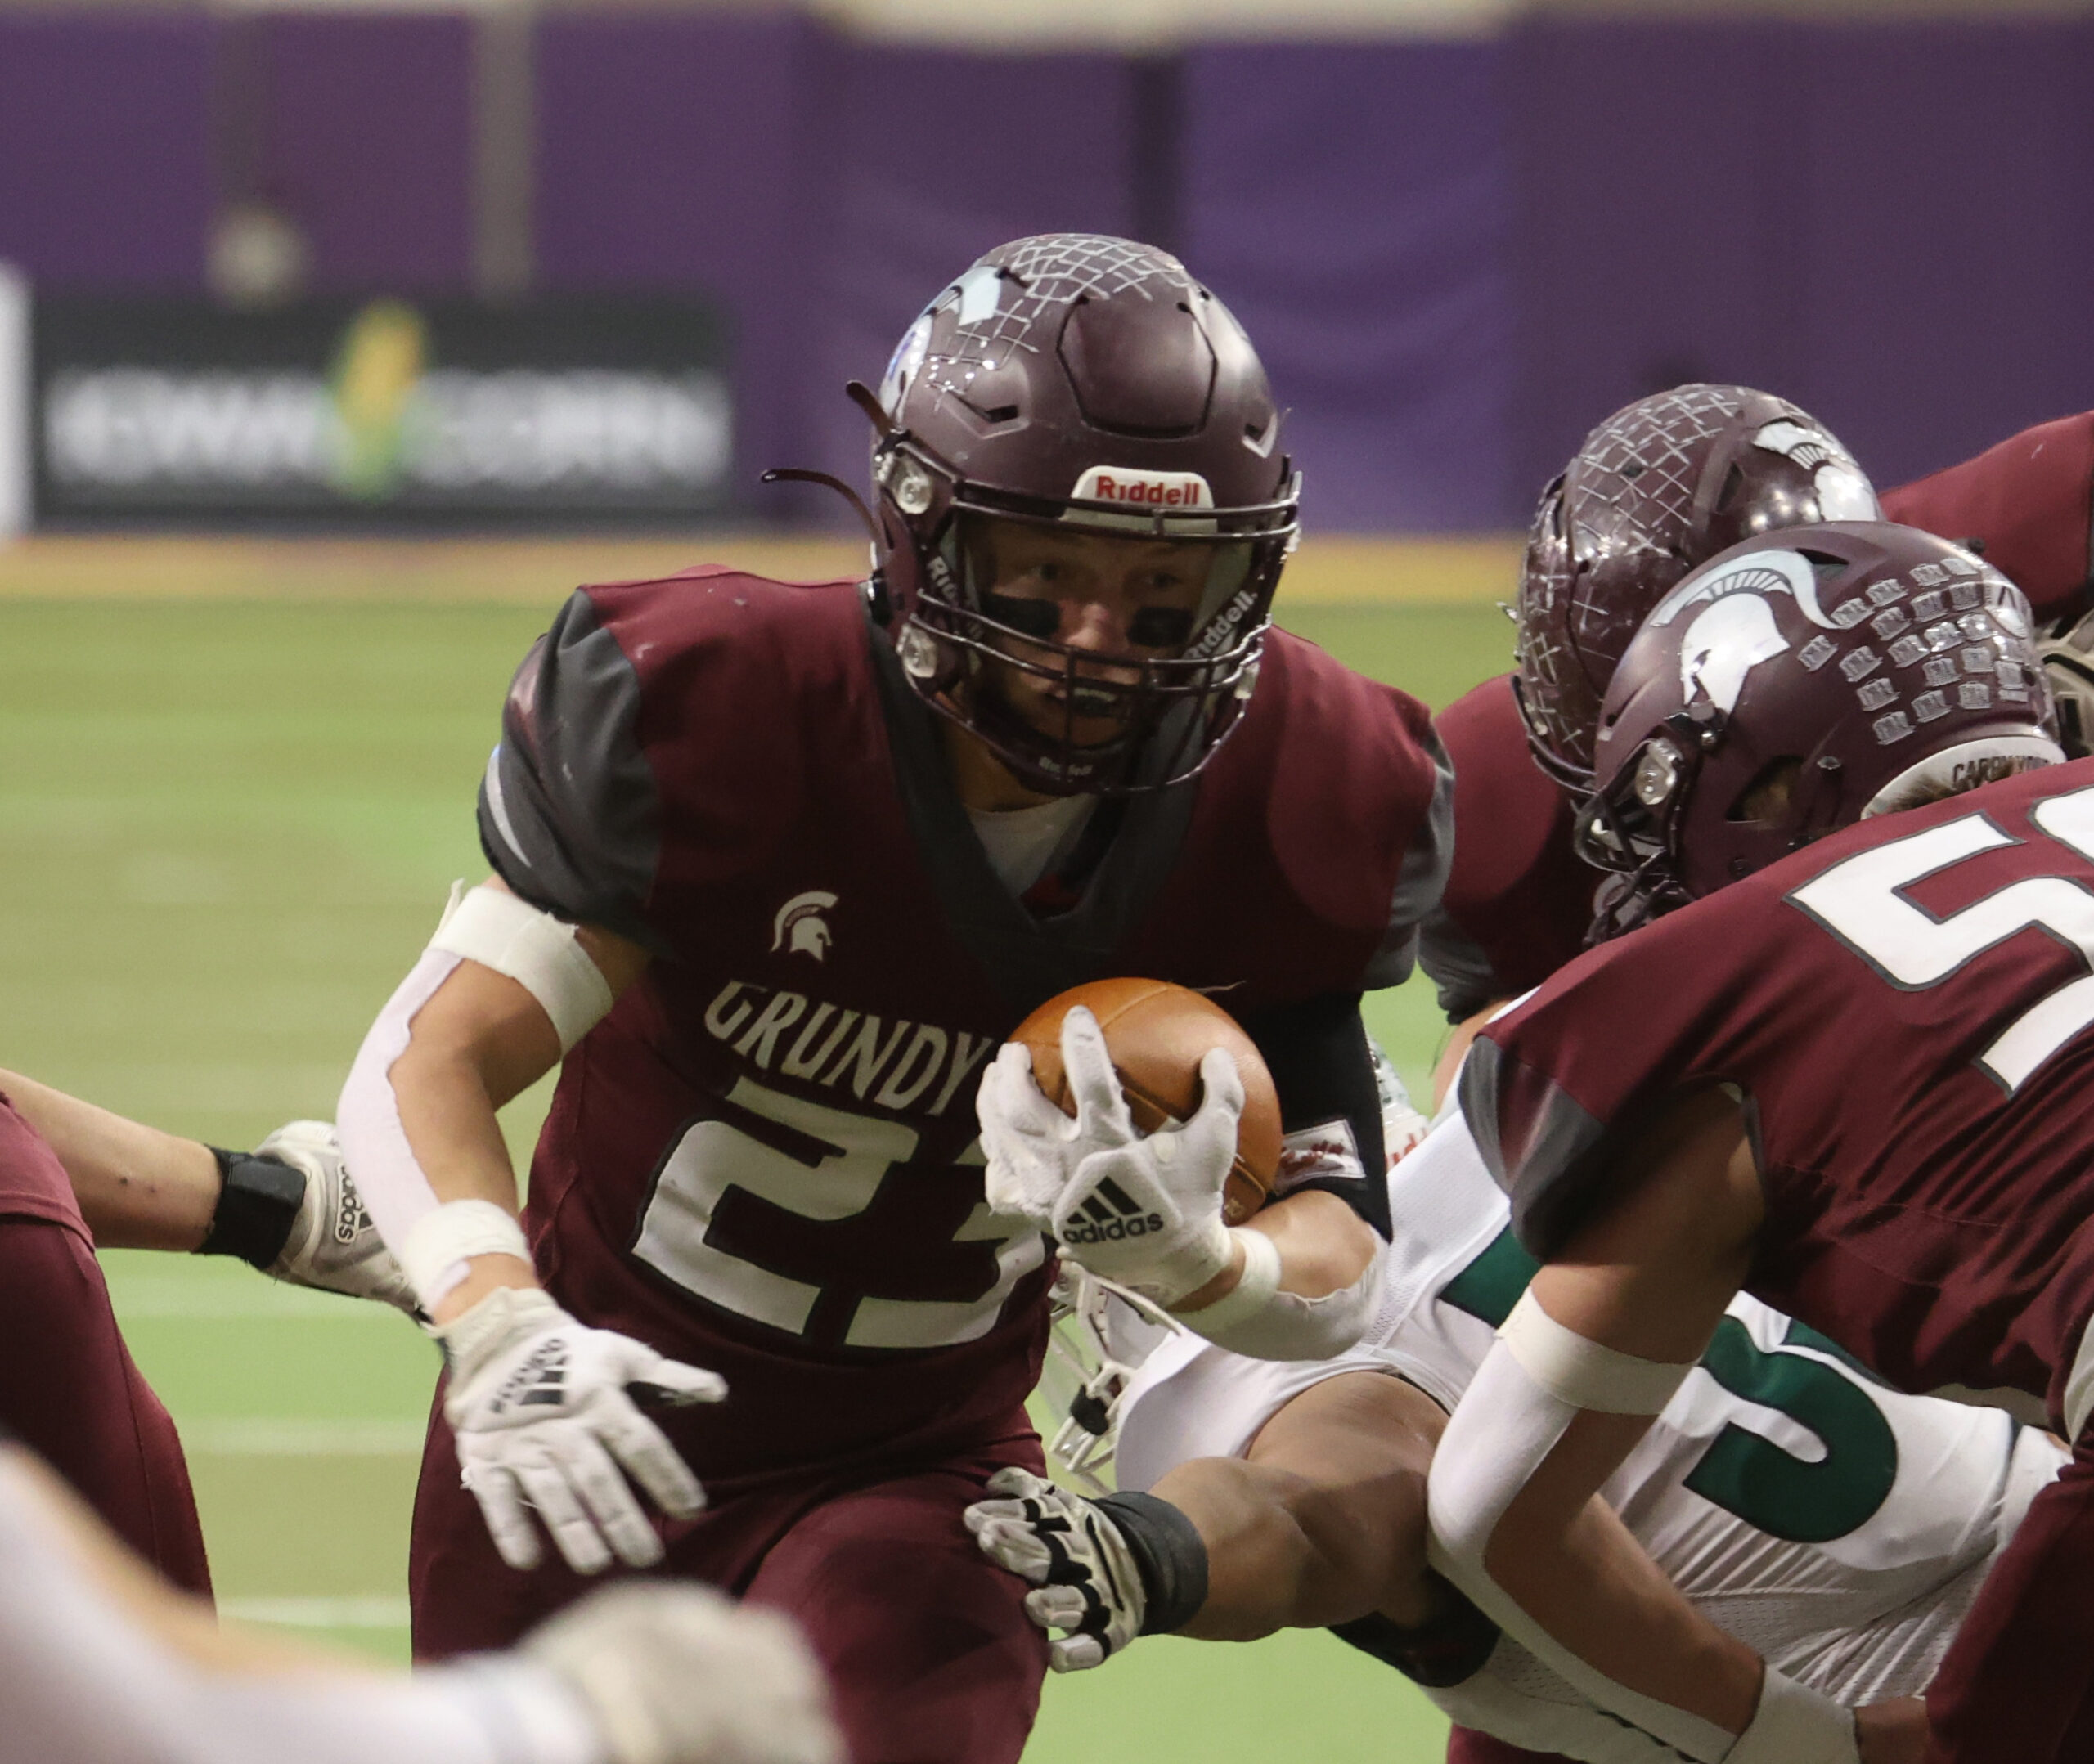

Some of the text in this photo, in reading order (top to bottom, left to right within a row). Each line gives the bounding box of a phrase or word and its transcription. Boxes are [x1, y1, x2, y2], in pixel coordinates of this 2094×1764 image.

[1096, 475, 1200, 505] Riddell
[704, 981, 995, 1116] GRUNDY
[1063, 1213, 1164, 1243] adidas
